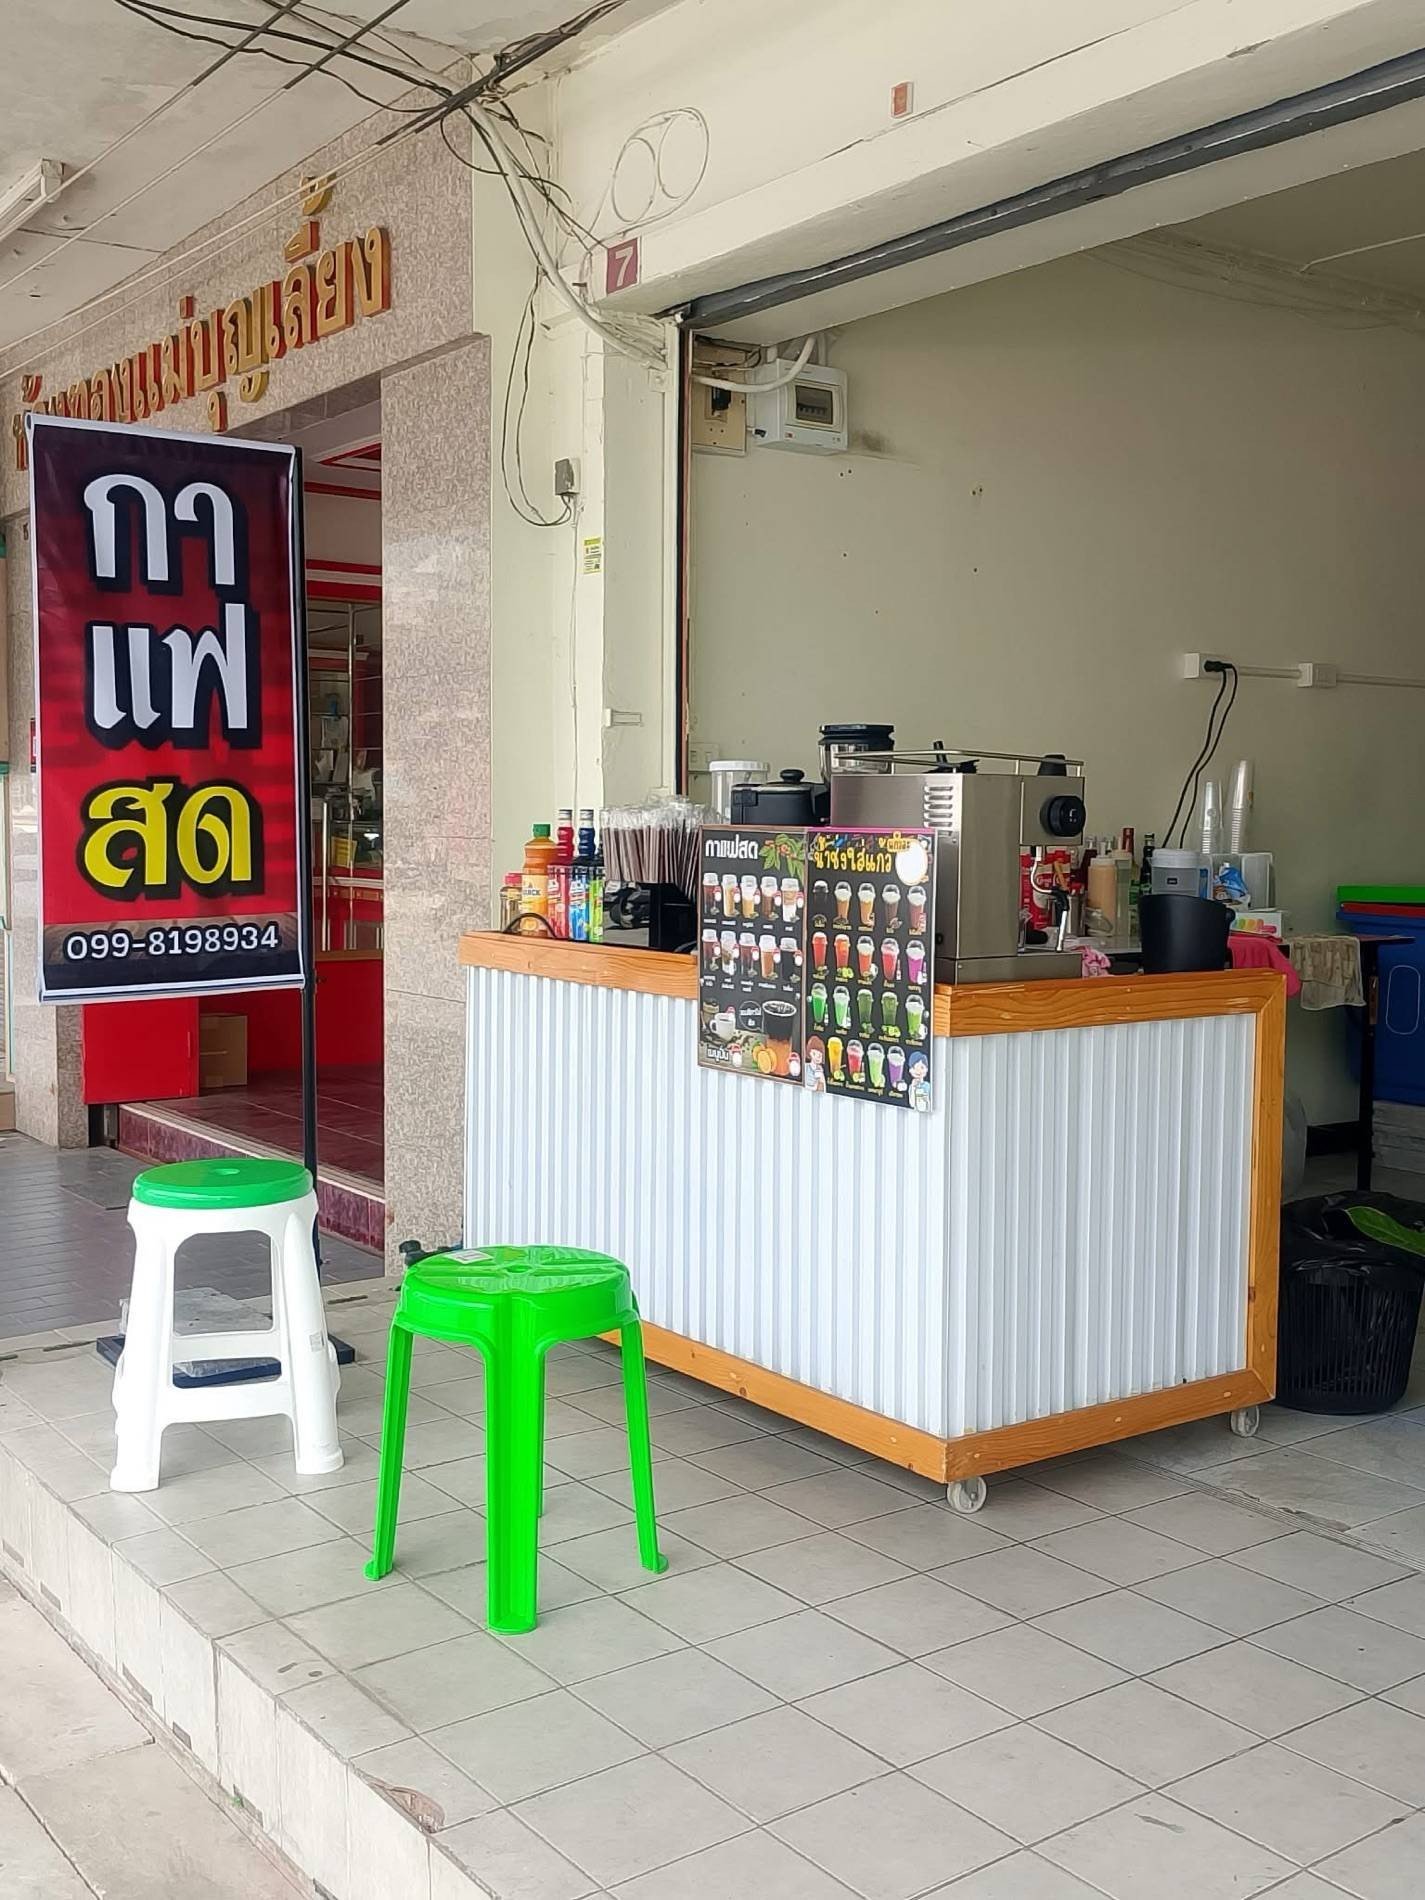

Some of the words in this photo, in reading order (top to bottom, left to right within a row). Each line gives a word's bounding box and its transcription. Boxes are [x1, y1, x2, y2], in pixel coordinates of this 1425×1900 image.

[615, 246, 634, 287] 7
[12, 175, 391, 471] ้ทองแม่บุญเลี้ยง
[83, 472, 236, 586] กา
[91, 603, 248, 730] แฟ
[83, 782, 253, 888] สด
[705, 834, 759, 860] กาแฟสด
[66, 931, 279, 961] 099-8198934
